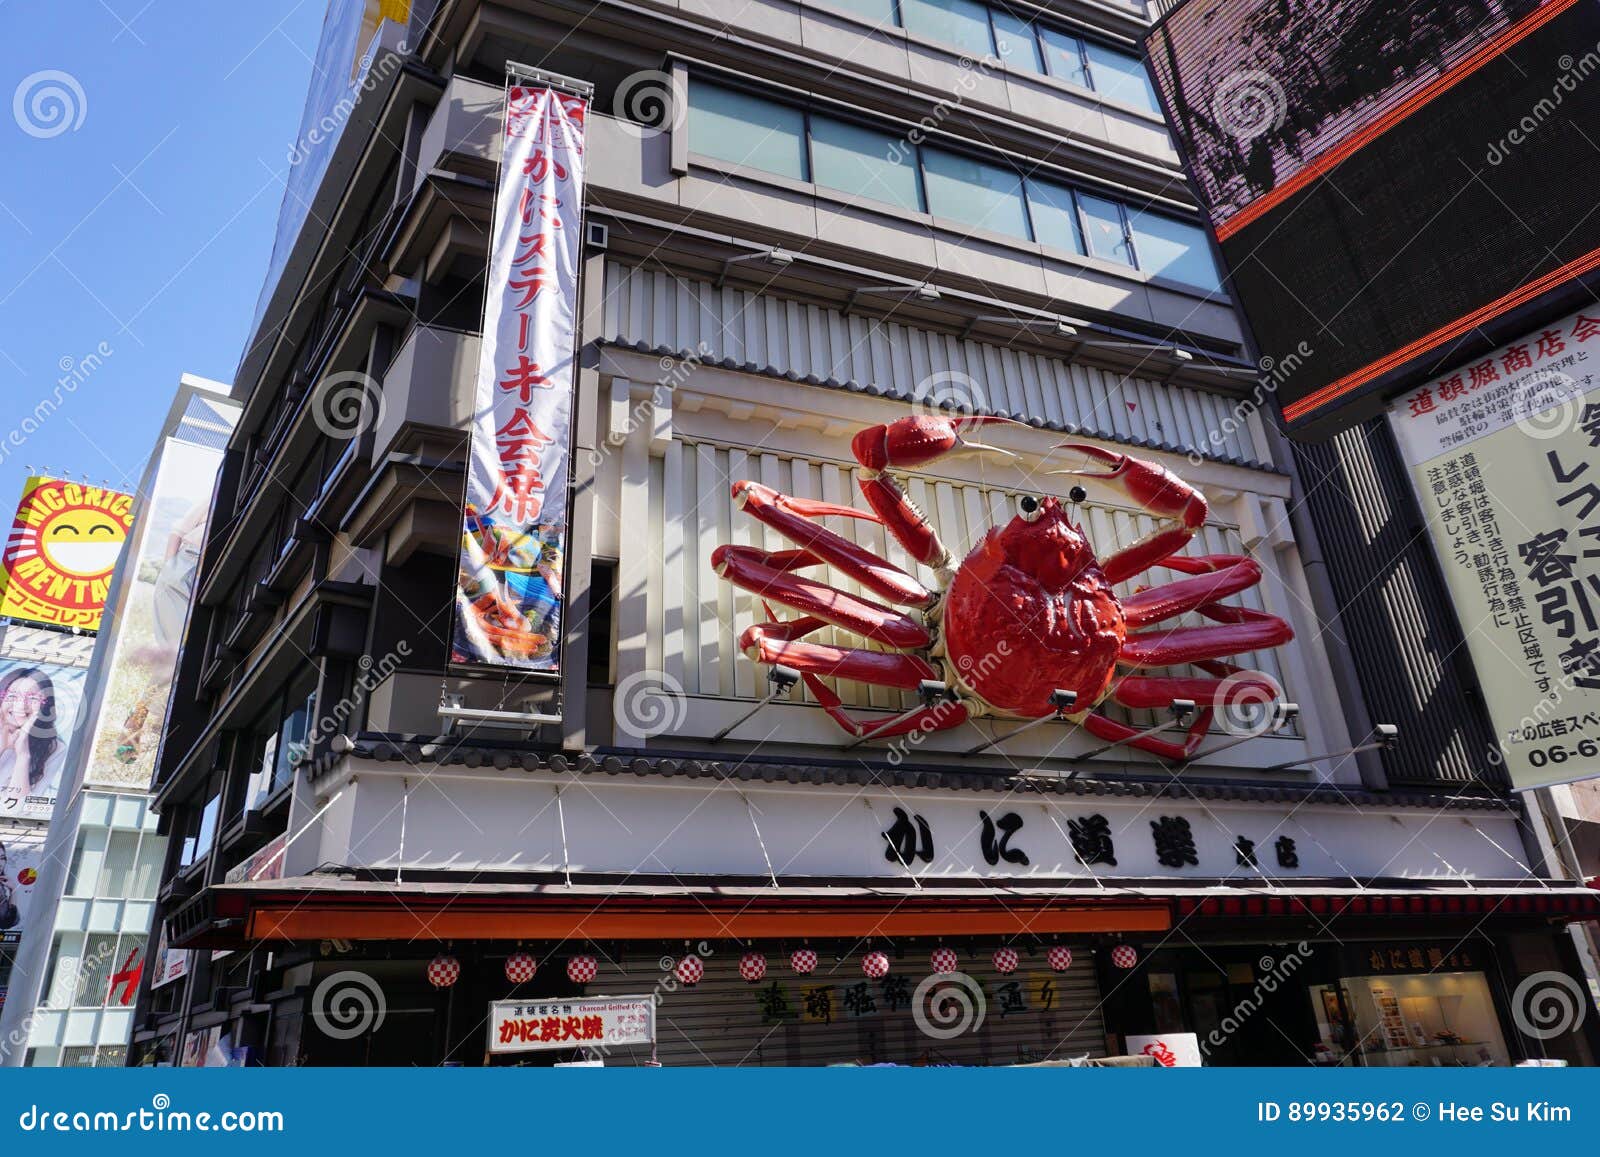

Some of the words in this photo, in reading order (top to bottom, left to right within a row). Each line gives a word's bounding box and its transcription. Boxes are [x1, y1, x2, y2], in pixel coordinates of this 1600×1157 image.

[485, 148, 568, 523] かにステーキ会席
[1407, 314, 1600, 419] 道頓堀商店会
[1427, 468, 1472, 568] 注意しましょう。
[15, 557, 112, 603] RENTA
[1508, 711, 1600, 744] この広告スペ
[1528, 737, 1600, 768] 06-6
[499, 1014, 604, 1044] かに炭火焼
